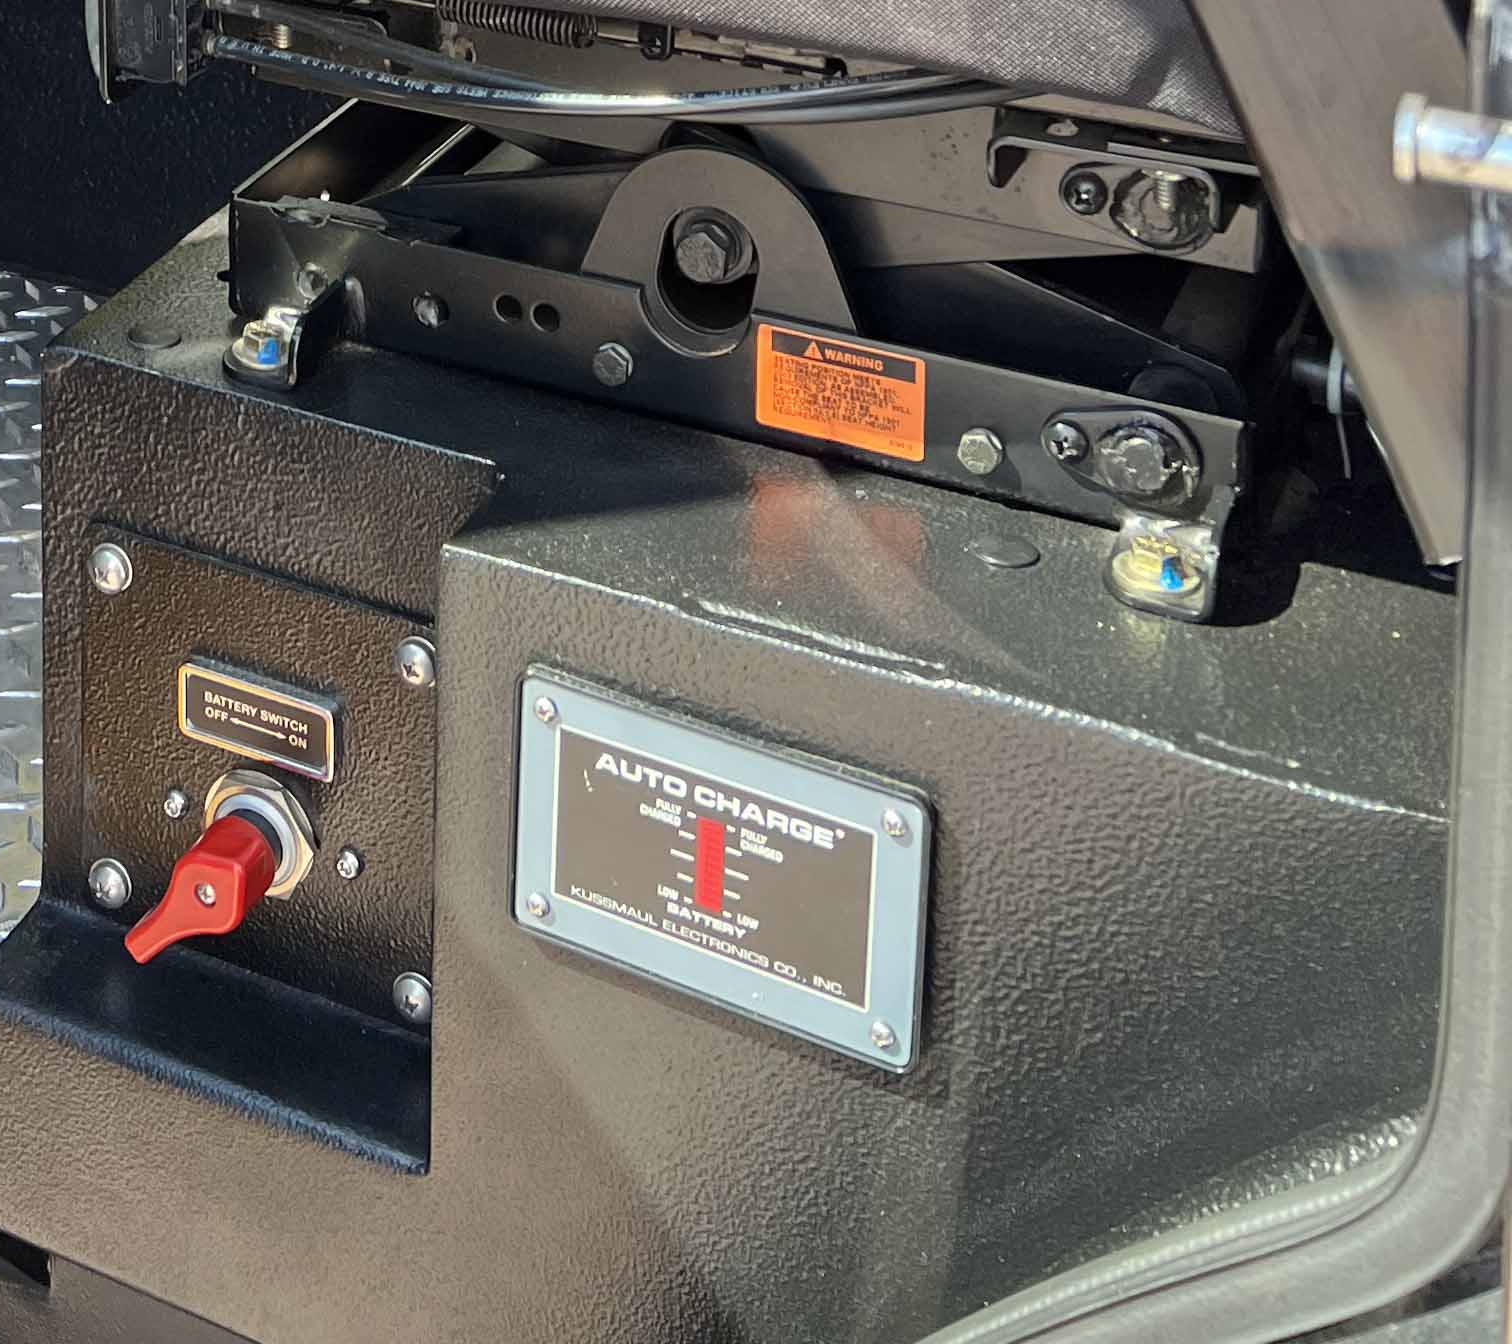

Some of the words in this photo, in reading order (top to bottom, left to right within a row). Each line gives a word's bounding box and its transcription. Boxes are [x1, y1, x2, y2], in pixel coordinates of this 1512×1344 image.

[824, 348, 884, 371] WARNING
[204, 691, 258, 717] BATTERY
[260, 710, 308, 735] SWITCH
[205, 706, 229, 722] OFF
[288, 734, 307, 749] ON
[595, 752, 687, 798] AUTO
[639, 803, 682, 827] CHARGED
[656, 798, 682, 815] FULLY
[740, 827, 768, 845] FULLY
[740, 839, 784, 863] CHARGED
[657, 884, 679, 900] LOW
[666, 901, 747, 939] BATTERY
[737, 913, 759, 930] LOW
[570, 885, 658, 927] KUSSMAUL
[662, 919, 769, 968] ELECTRONICS
[813, 975, 847, 997] INC.
